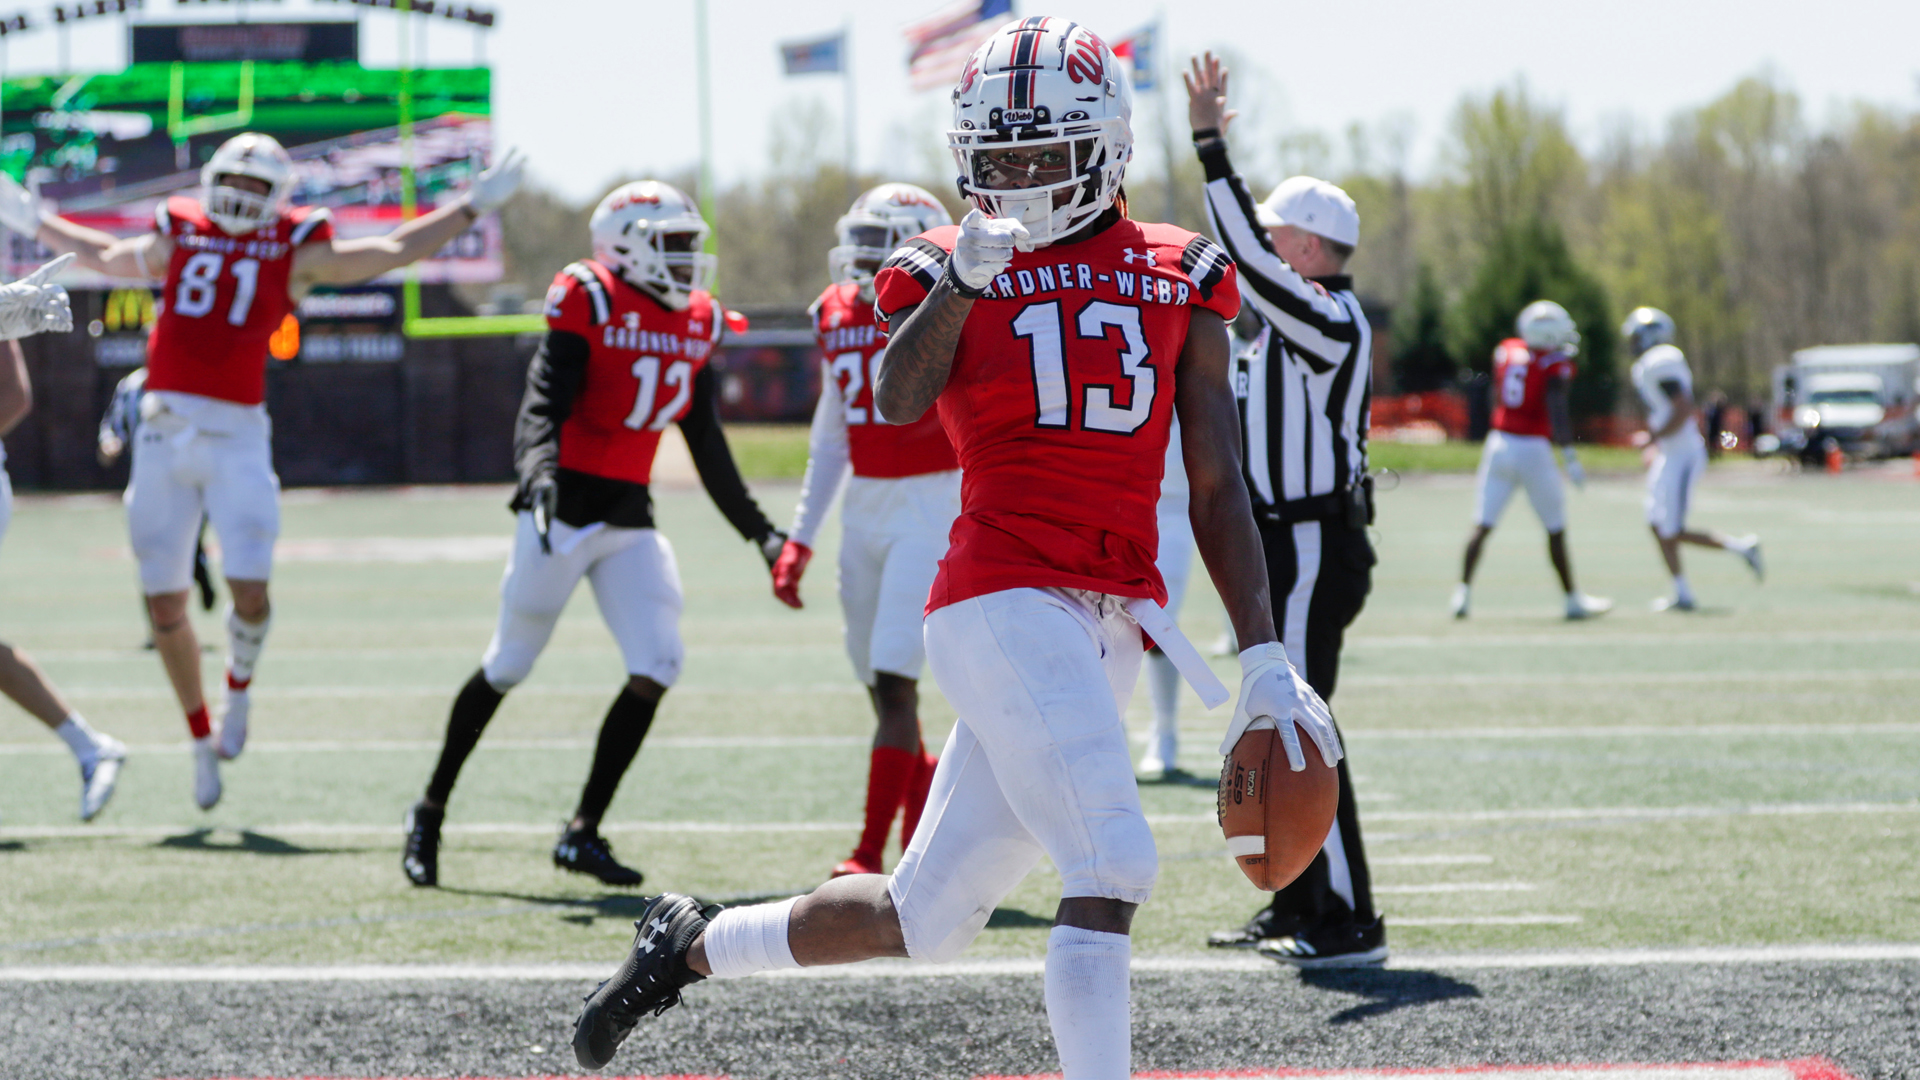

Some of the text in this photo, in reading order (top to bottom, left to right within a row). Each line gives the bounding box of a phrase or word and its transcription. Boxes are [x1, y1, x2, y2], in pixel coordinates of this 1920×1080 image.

[173, 251, 261, 327] 81
[981, 262, 1190, 306] ARDNER-WEBB
[1008, 297, 1158, 437] 13
[623, 355, 692, 431] 12
[1234, 761, 1245, 805] GST
[1246, 769, 1256, 797] NCAA
[1245, 857, 1266, 865] GST
